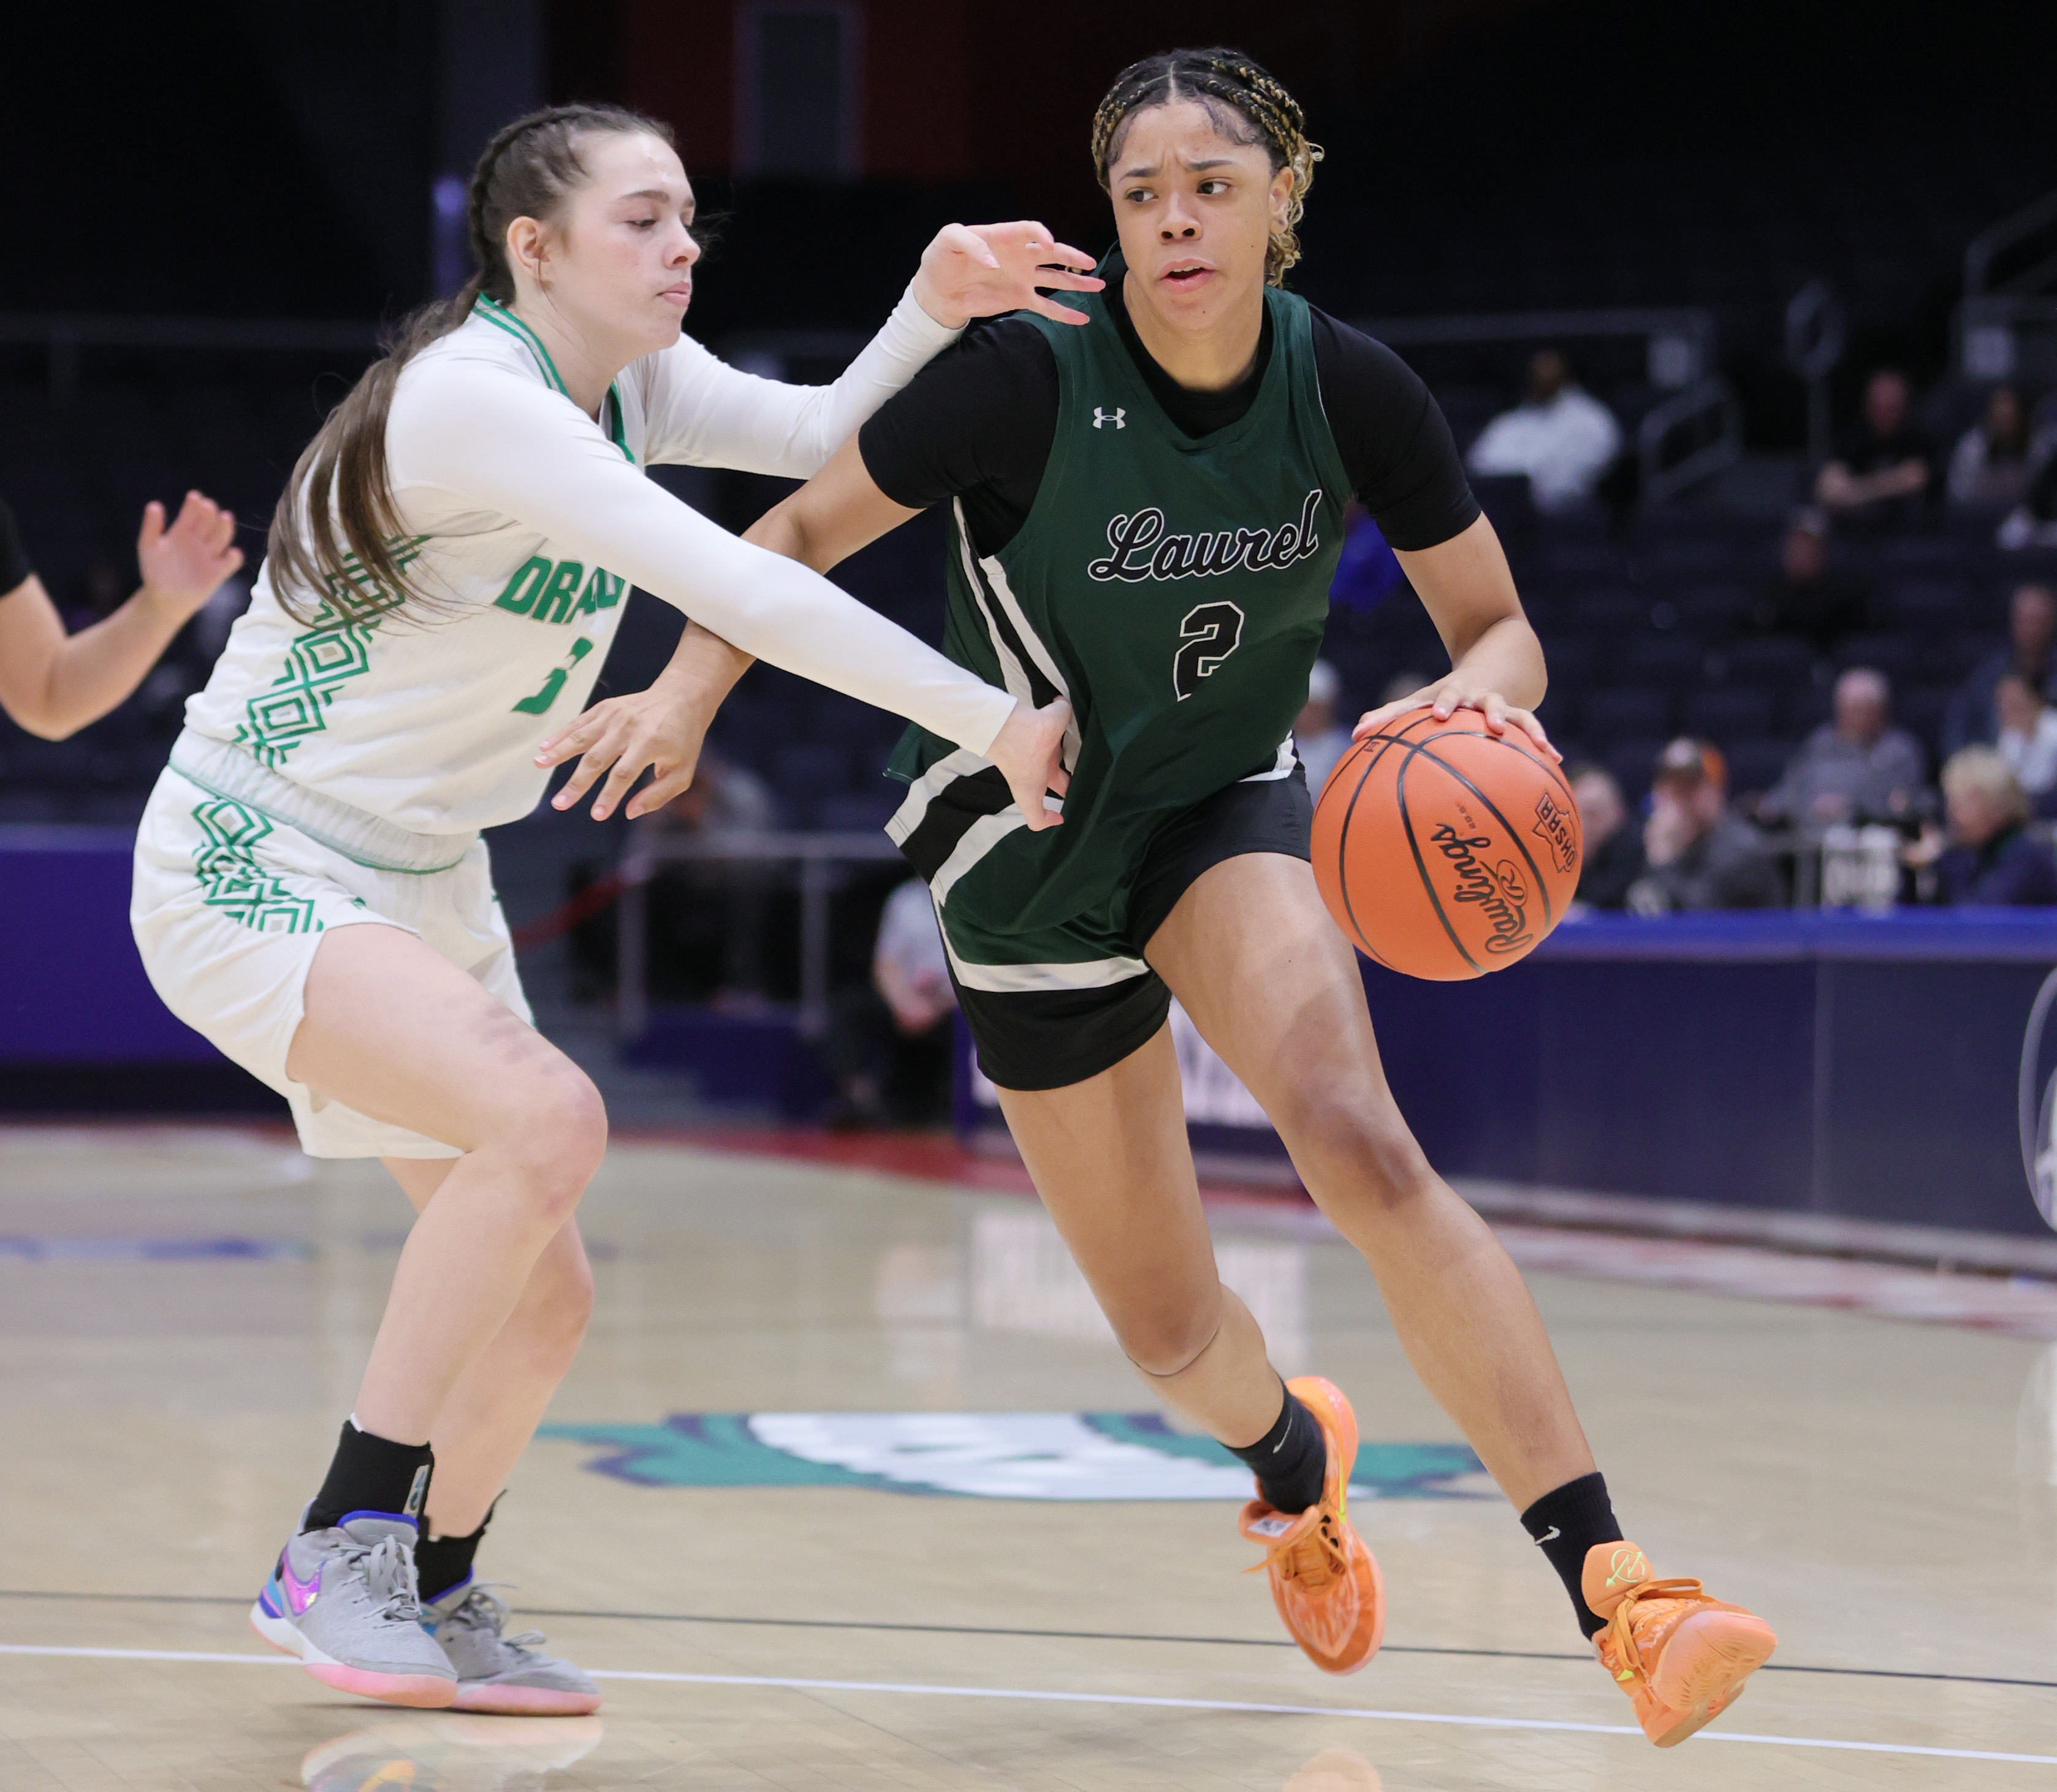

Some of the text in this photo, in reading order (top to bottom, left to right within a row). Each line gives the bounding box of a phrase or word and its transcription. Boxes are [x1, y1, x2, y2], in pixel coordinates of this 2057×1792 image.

[1087, 488, 1322, 583] Laurel
[1173, 601, 1244, 702] 2
[1540, 800, 1575, 865] OHSAA
[1430, 822, 1534, 954] Rawlings
